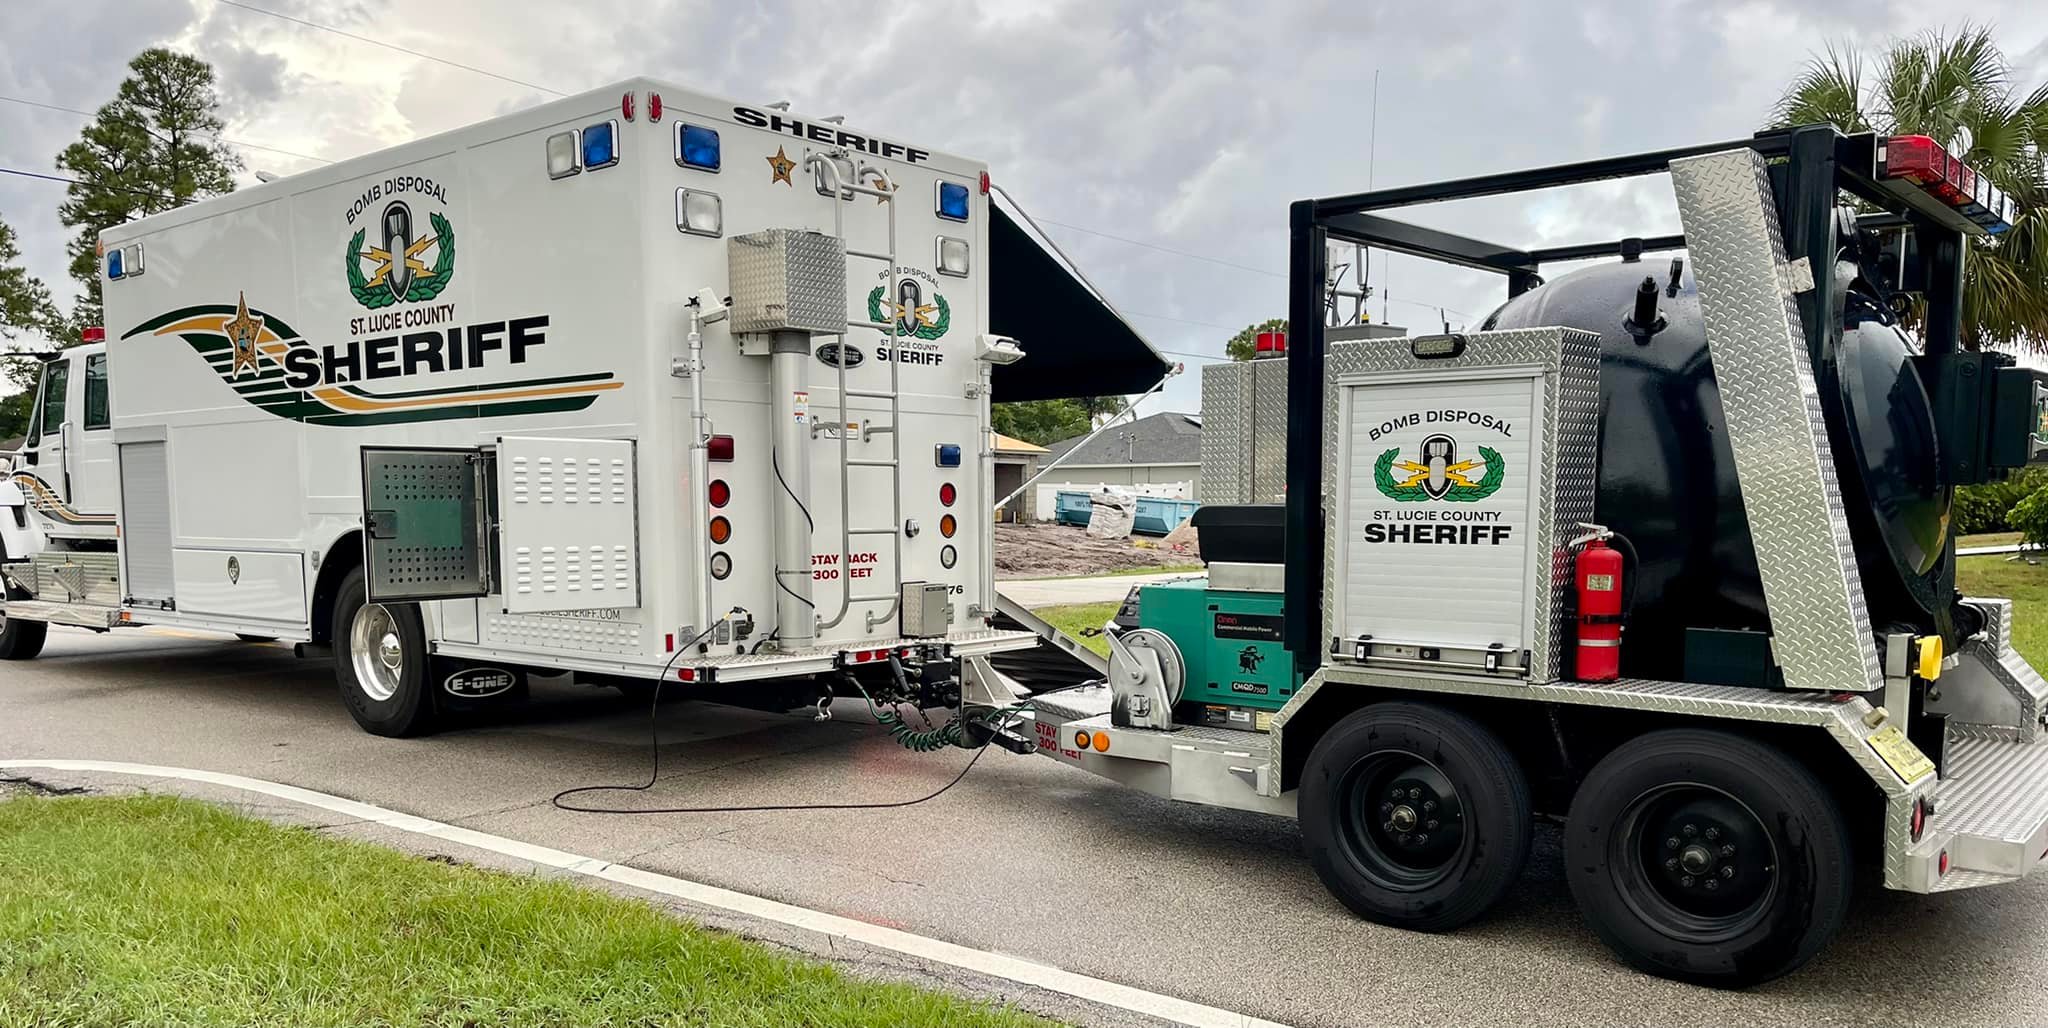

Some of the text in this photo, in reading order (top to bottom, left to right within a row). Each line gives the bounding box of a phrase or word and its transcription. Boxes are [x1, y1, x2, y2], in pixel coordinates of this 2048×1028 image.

[733, 107, 929, 163] SHERIFF
[346, 177, 447, 225] BOMB DISPOSAL
[878, 266, 939, 289] BOB DISPOSAL
[350, 304, 455, 335] ST. LUCIE COUNTY
[284, 315, 550, 389] SHERIFF
[912, 342, 939, 351] COUNTY
[1369, 410, 1513, 441] BOMB DISPOSAL
[1373, 510, 1502, 522] ST. LUCIE COUNTY
[1364, 523, 1512, 545] SHERIFF
[812, 568, 873, 580] 300 EET
[452, 675, 508, 691] E-ONE
[1034, 722, 1057, 738] STAY
[1039, 736, 1057, 752] 300
